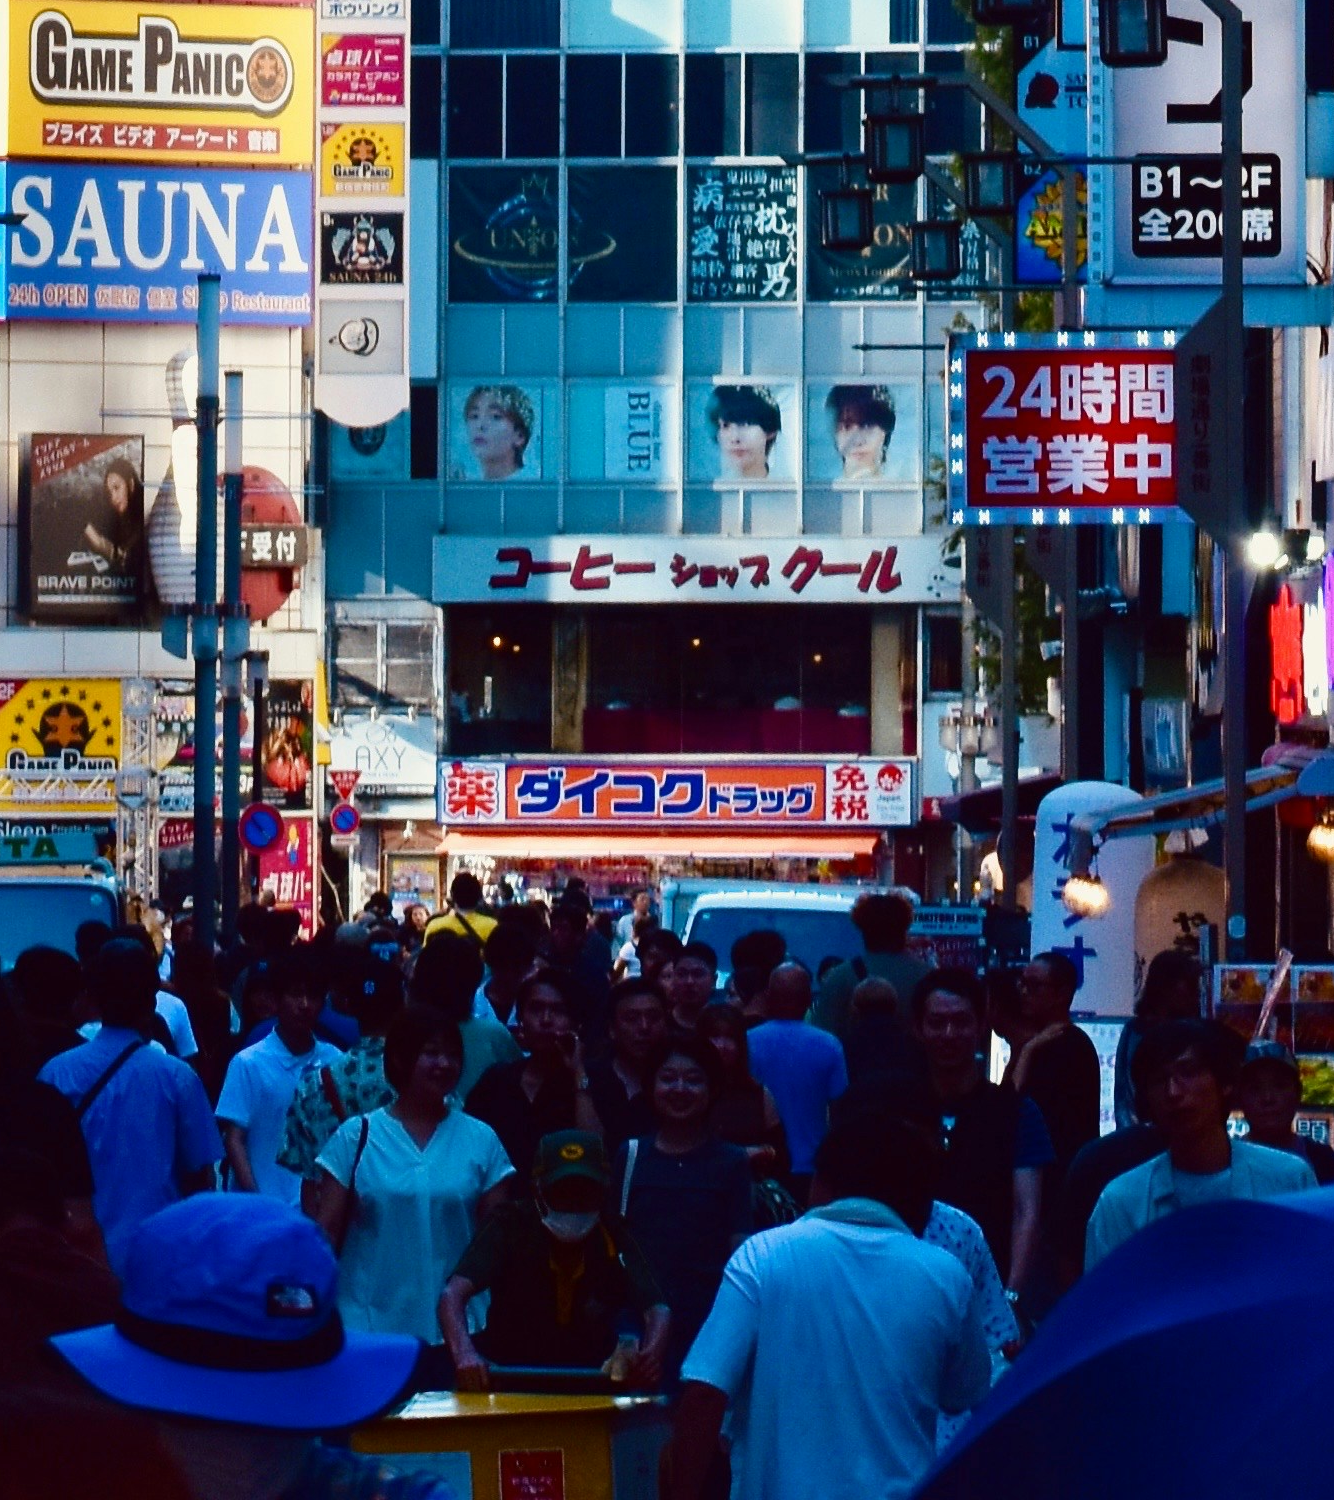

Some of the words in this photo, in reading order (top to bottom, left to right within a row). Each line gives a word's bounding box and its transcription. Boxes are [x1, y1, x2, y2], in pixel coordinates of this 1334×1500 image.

[329, 1, 400, 18] ボウリング
[34, 17, 134, 95] GAME
[45, 122, 104, 146] プライズ
[113, 125, 157, 149] ビデオ
[166, 127, 239, 151] アーケード
[332, 163, 361, 180] GAME
[360, 162, 393, 181] PANIC
[10, 175, 310, 272] SAUNA
[8, 284, 41, 307] 24h
[42, 284, 89, 308] OPEN
[231, 290, 312, 313] Restaurant
[329, 271, 371, 285] SAUNA
[981, 363, 1175, 425] 24時間
[626, 391, 653, 474] BLUE
[981, 433, 1173, 495] 営業中
[37, 574, 88, 590] BRAVE
[90, 574, 138, 589] POINT
[488, 543, 658, 592] コーヒー
[668, 552, 770, 590] ショップ
[779, 545, 904, 593] クール
[353, 745, 406, 770] AXY
[442, 762, 502, 820] 薬
[515, 769, 816, 815] ダイコクドラッグ
[831, 763, 871, 822] 免税
